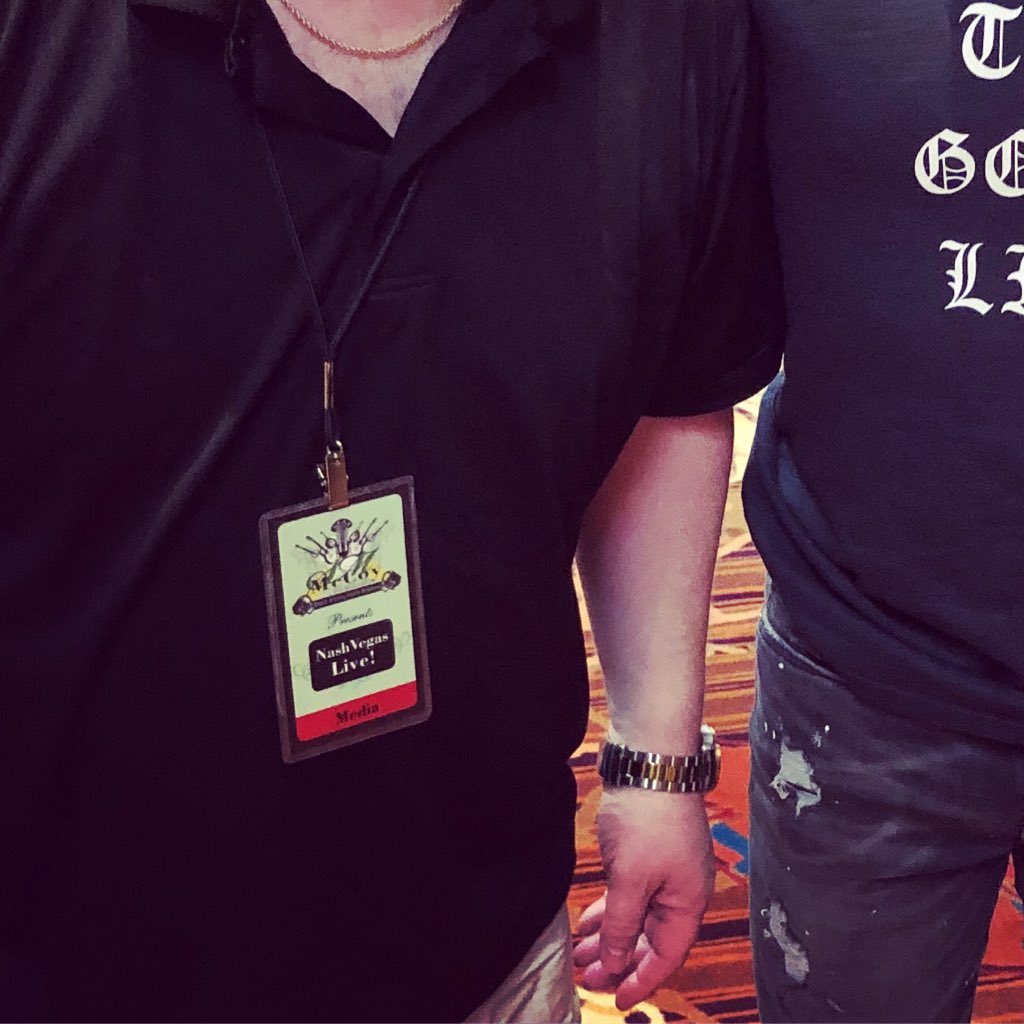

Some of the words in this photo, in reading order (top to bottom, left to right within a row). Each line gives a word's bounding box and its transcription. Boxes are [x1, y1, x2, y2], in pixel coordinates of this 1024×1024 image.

[315, 633, 389, 662] NashVegas
[331, 650, 376, 677] Live!
[335, 702, 380, 726] Media
